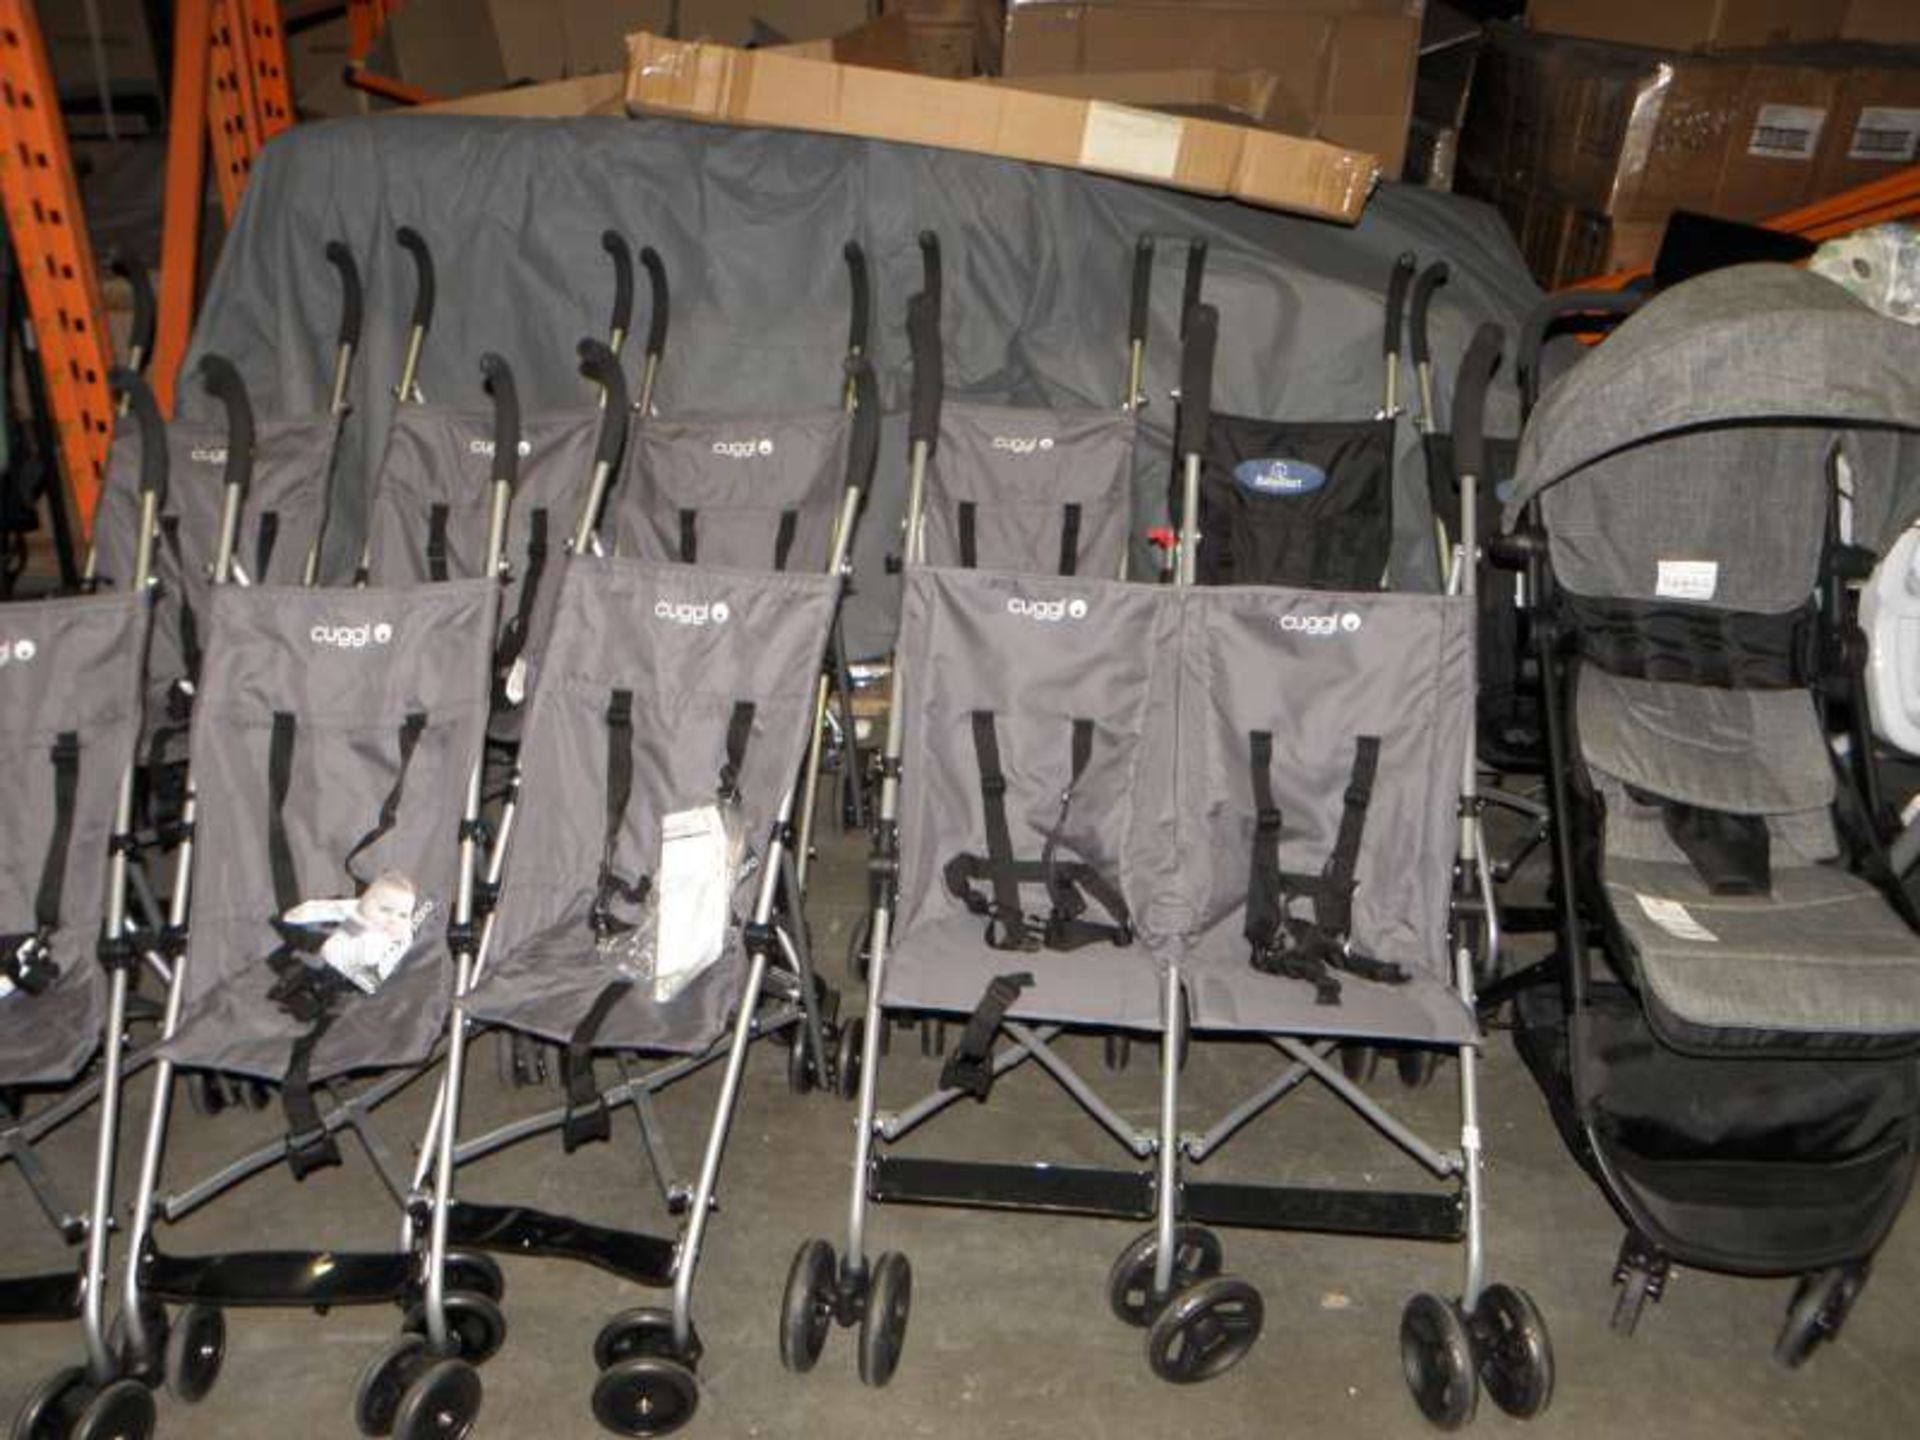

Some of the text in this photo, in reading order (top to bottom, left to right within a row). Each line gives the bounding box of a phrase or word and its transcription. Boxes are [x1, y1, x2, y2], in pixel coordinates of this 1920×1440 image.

[654, 600, 708, 625] cuggl
[1007, 597, 1067, 621] cuggl
[310, 622, 370, 647] cuggl
[1280, 613, 1338, 635] cuggl
